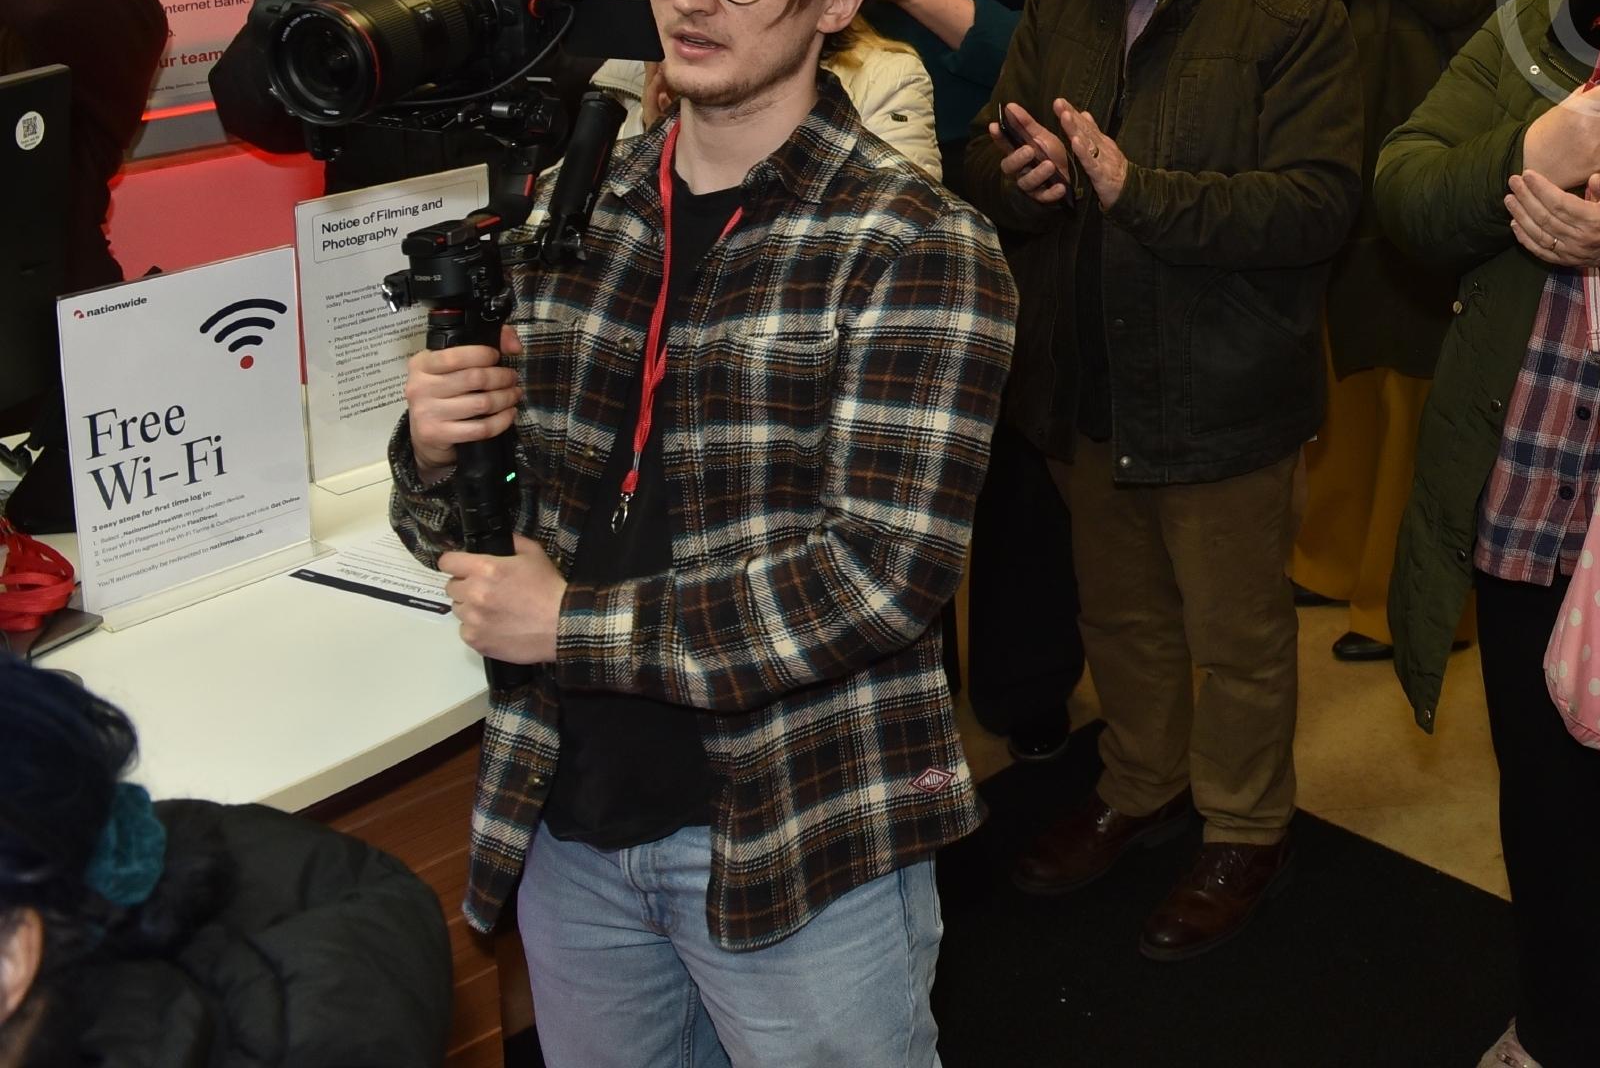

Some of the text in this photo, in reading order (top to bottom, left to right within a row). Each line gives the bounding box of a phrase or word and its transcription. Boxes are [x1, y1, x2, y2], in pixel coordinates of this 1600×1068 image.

[163, 0, 212, 15] nternet
[321, 197, 443, 234] Notice of Filming and
[322, 226, 398, 251] Photography
[87, 296, 148, 317] nationwide
[82, 403, 186, 460] Free
[87, 435, 227, 511] Wi-Fi
[91, 525, 98, 533] 3
[98, 519, 118, 531] easy
[118, 513, 141, 525] steps
[141, 508, 154, 517] for
[154, 503, 171, 512] first
[171, 497, 189, 507] time
[190, 492, 202, 502] log
